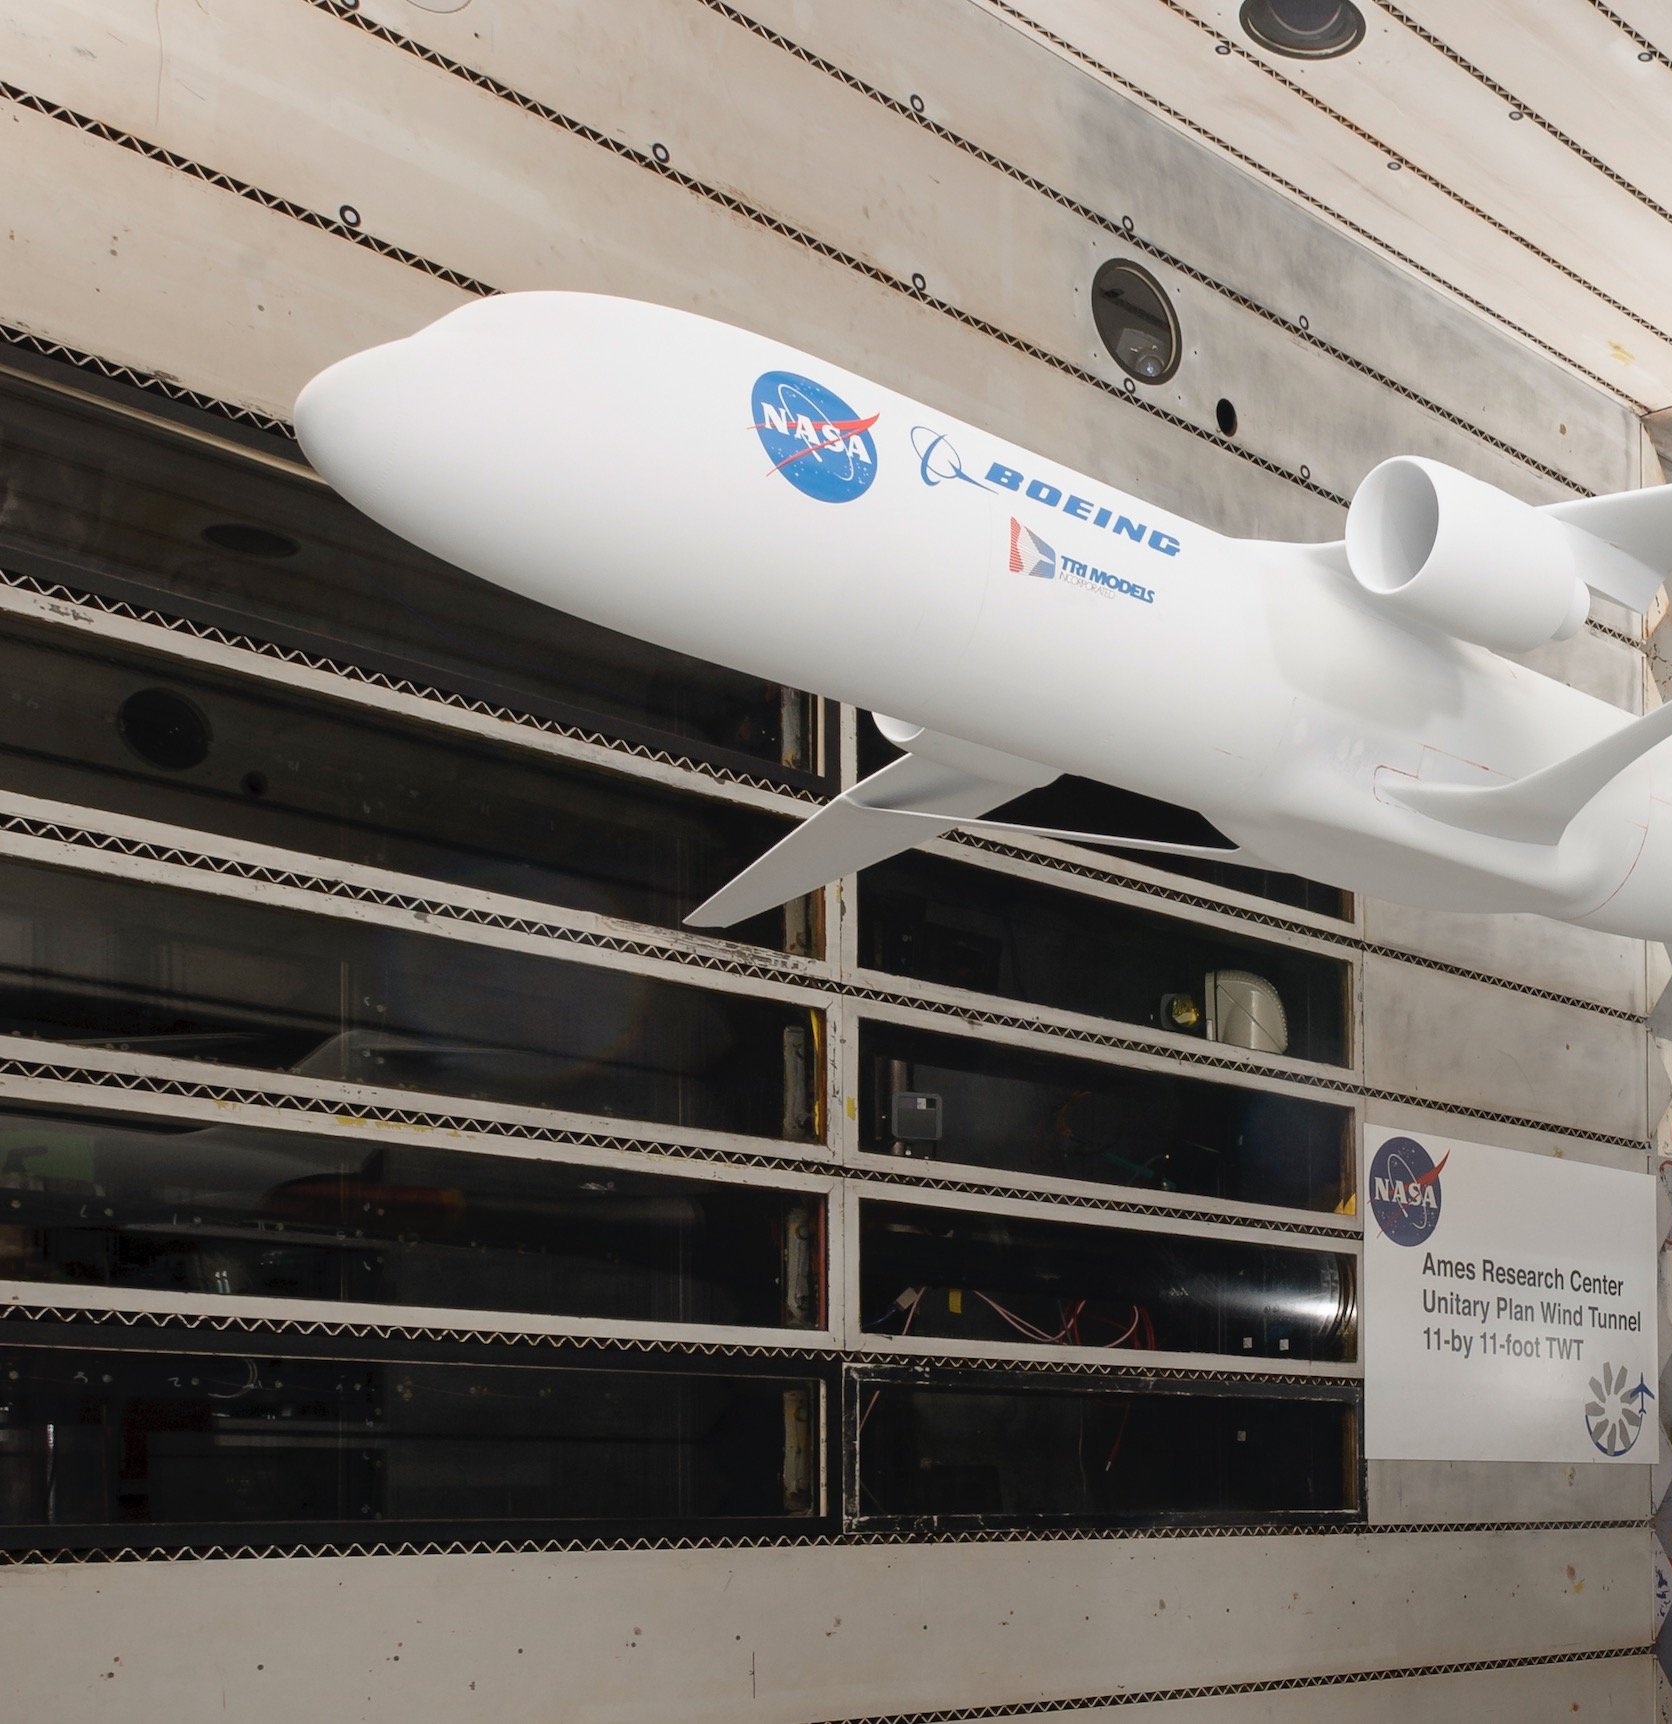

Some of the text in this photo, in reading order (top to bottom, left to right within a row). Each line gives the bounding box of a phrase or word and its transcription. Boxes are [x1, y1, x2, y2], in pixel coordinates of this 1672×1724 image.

[761, 402, 872, 464] NASA
[984, 462, 1181, 557] BOEING
[1061, 555, 1156, 604] TRI MODELS
[1374, 1176, 1438, 1209] NASA
[1422, 1252, 1624, 1297] Ames Research Center
[1422, 1289, 1641, 1332] Unitary Plan Wind Tunnel
[1423, 1327, 1584, 1361] 11-by 11-foot TWT
